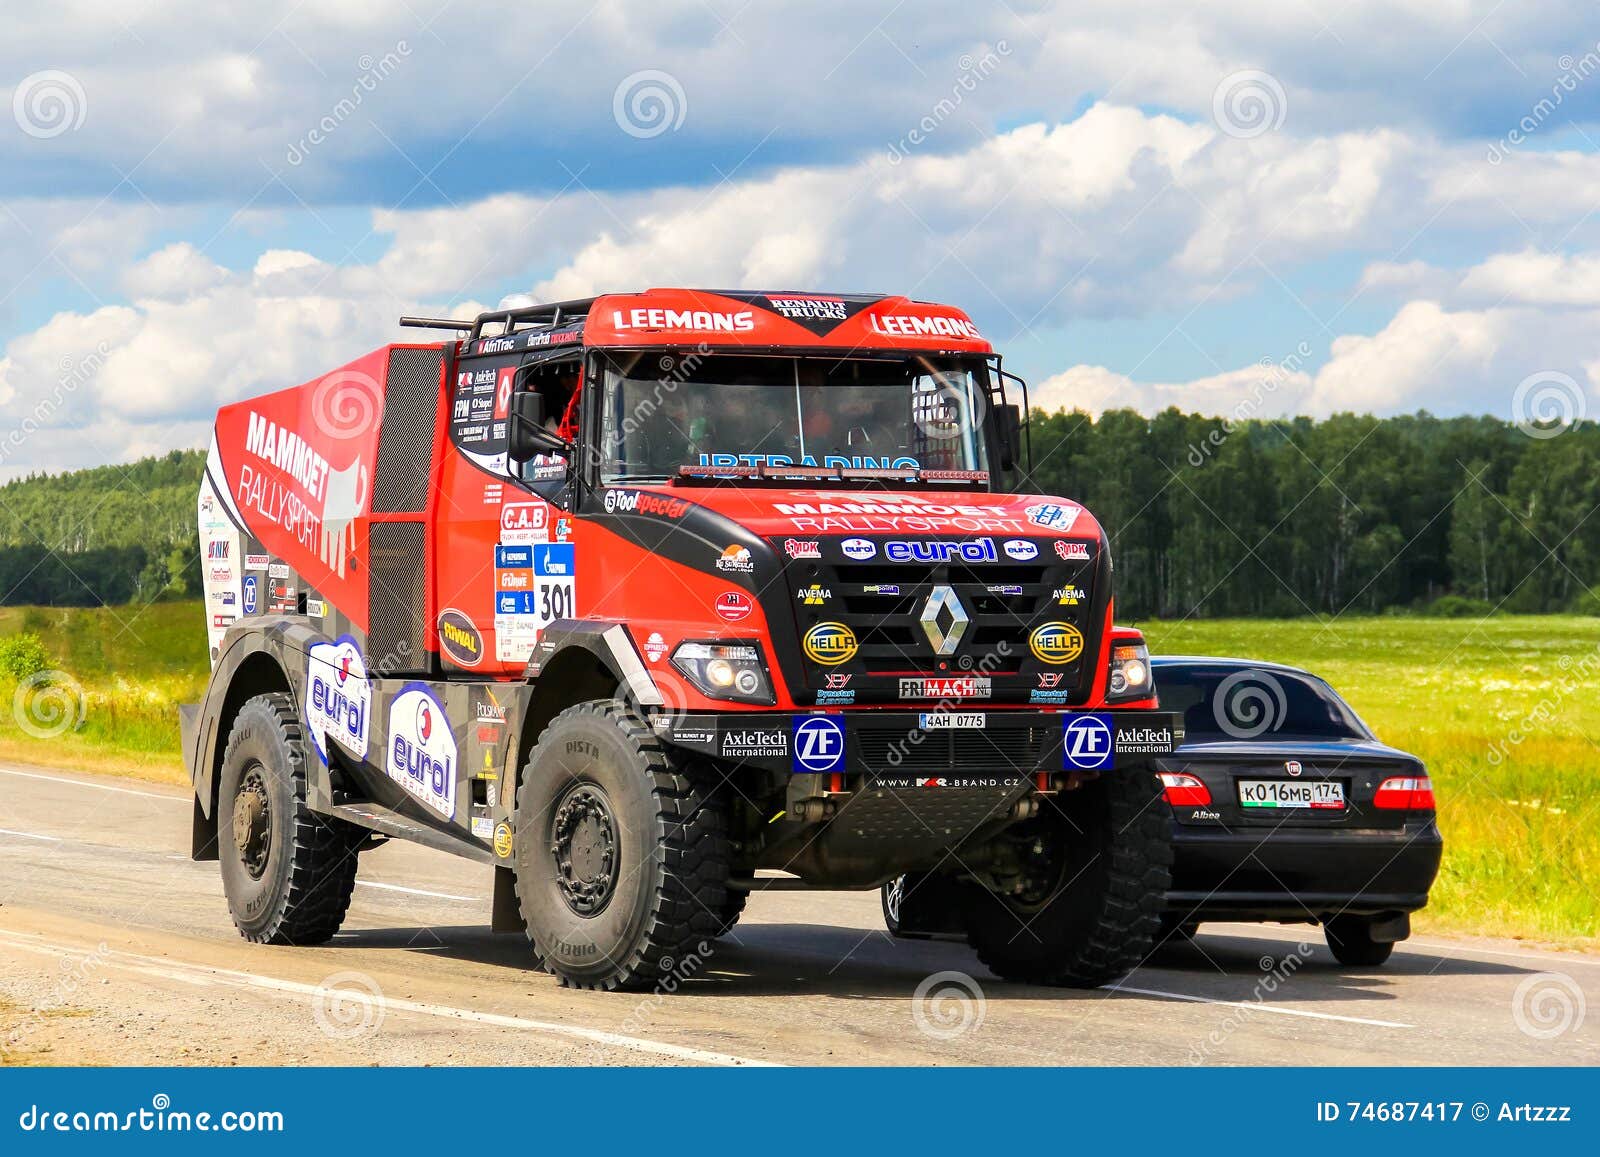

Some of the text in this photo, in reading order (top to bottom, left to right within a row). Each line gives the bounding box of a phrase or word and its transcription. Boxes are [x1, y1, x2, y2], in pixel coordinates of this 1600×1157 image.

[771, 299, 847, 311] RENAULT
[613, 309, 755, 331] LEEMANS
[778, 307, 848, 320] TRUCKS
[870, 313, 982, 338] LEEMANS
[483, 339, 515, 354] AfriTrac
[454, 399, 470, 418] FPM
[246, 411, 329, 503] MAMMOET
[237, 464, 320, 556] RALLYSPORT
[772, 503, 1008, 517] MAMMOET
[789, 516, 1026, 534] RALLYSPORT
[796, 541, 819, 553] MDK
[845, 545, 873, 553] eurol
[884, 537, 998, 562] eurol
[1007, 545, 1035, 553] eurol
[1063, 543, 1086, 555] MDK
[797, 589, 832, 598] AVEMA
[1052, 589, 1085, 599] AVEMA
[540, 584, 572, 621] 301
[444, 621, 477, 653] RIWAL
[810, 636, 857, 650] HELLA
[1037, 636, 1081, 649] HELLA
[312, 676, 367, 742] eurol
[927, 715, 983, 727] 4AH 0775
[723, 731, 787, 745] AxleTech
[1069, 727, 1107, 757] ZF
[1116, 728, 1171, 742] AxleTech
[800, 728, 841, 760] ZF
[1116, 743, 1172, 753] International
[723, 747, 788, 757] International
[393, 733, 451, 802] eurol
[1316, 784, 1340, 797] 174
[1191, 810, 1221, 820] Albea
